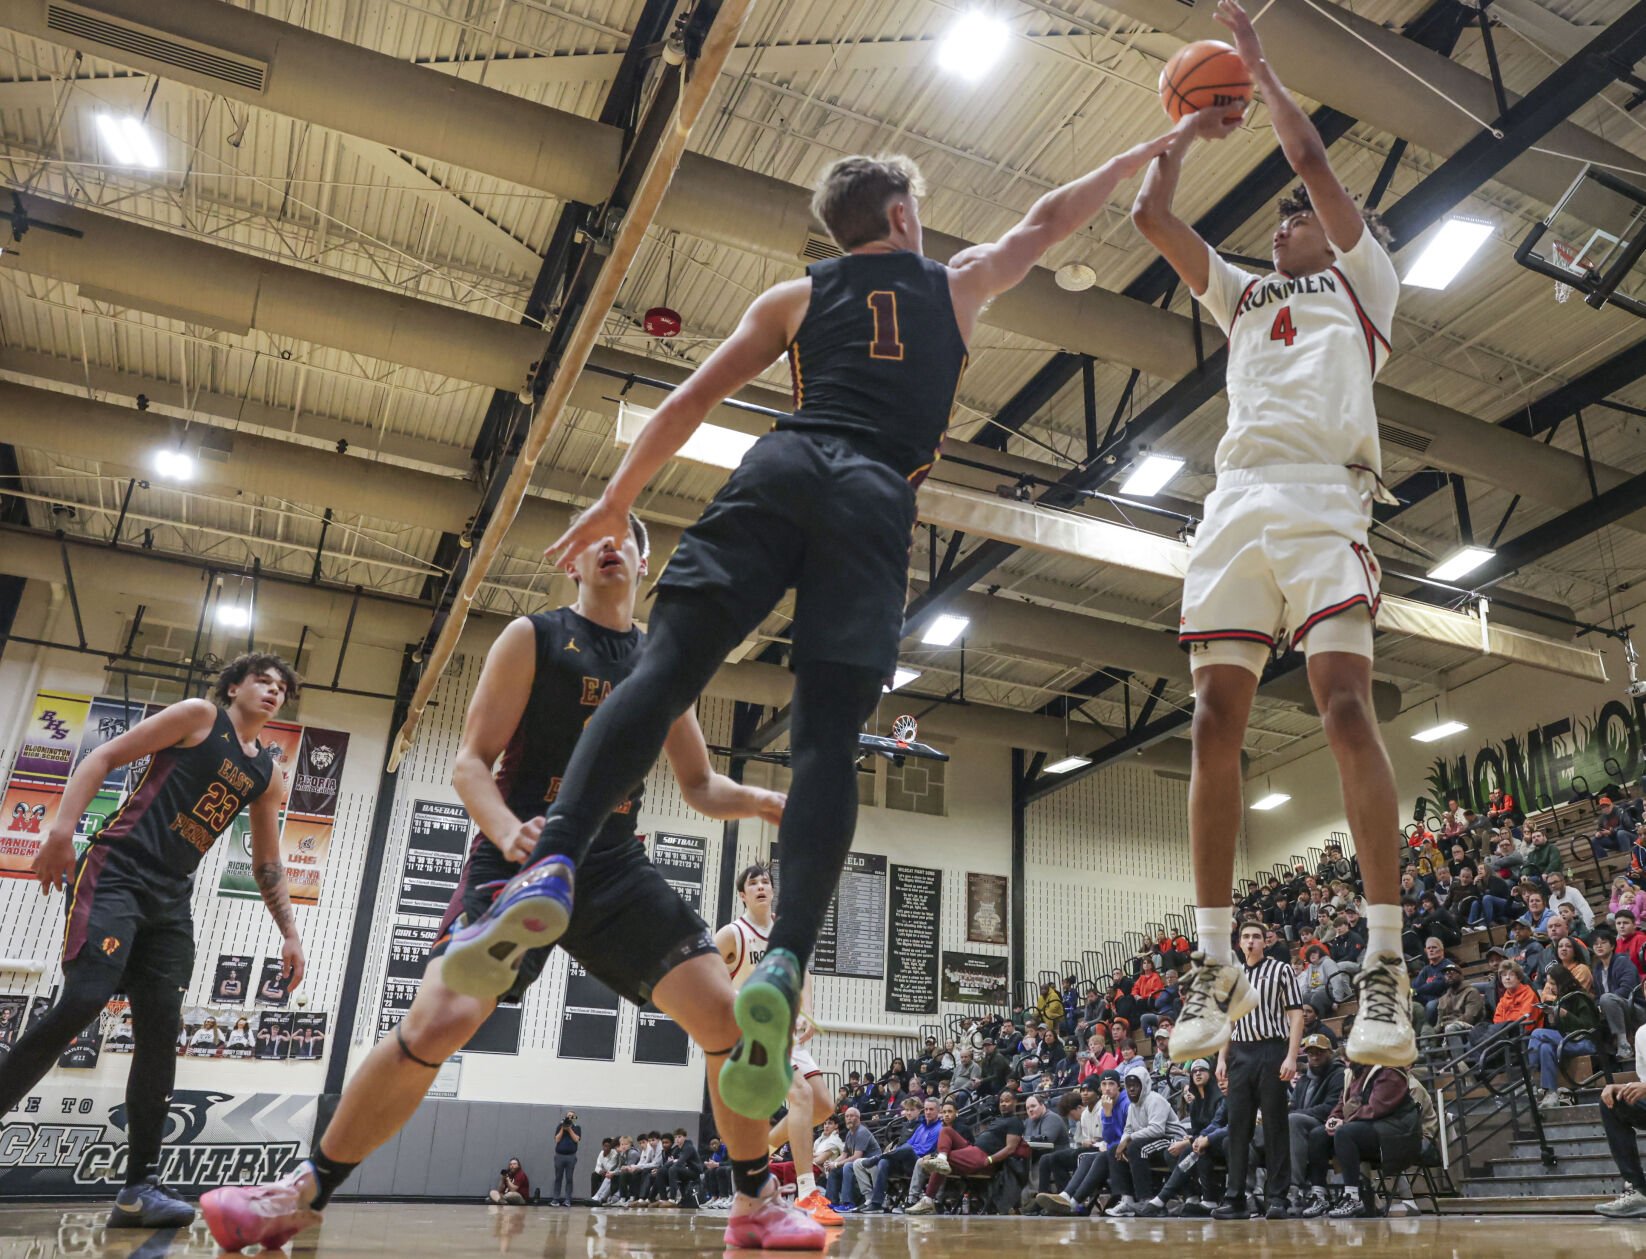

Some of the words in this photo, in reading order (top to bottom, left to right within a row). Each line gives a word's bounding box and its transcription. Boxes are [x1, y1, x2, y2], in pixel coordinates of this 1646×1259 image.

[867, 290, 904, 361] 1
[1270, 305, 1297, 346] 4
[38, 710, 70, 740] BHS
[24, 744, 72, 757] BLOOMINGTON
[41, 752, 70, 762] SCHOOL
[1438, 717, 1573, 816] HOME
[217, 758, 255, 796] EAST
[296, 774, 337, 790] PEORIA
[192, 782, 240, 832] 23
[422, 804, 464, 816] BASEBALL
[663, 836, 698, 847] SOFTBALL
[0, 846, 39, 857] CADEM
[228, 861, 252, 870] RICHW
[288, 854, 317, 865] UHS
[845, 856, 865, 866] ELD
[285, 867, 320, 879] RBANA
[395, 929, 418, 937] GIRLS
[420, 931, 438, 939] SOC
[62, 1097, 93, 1113] TO
